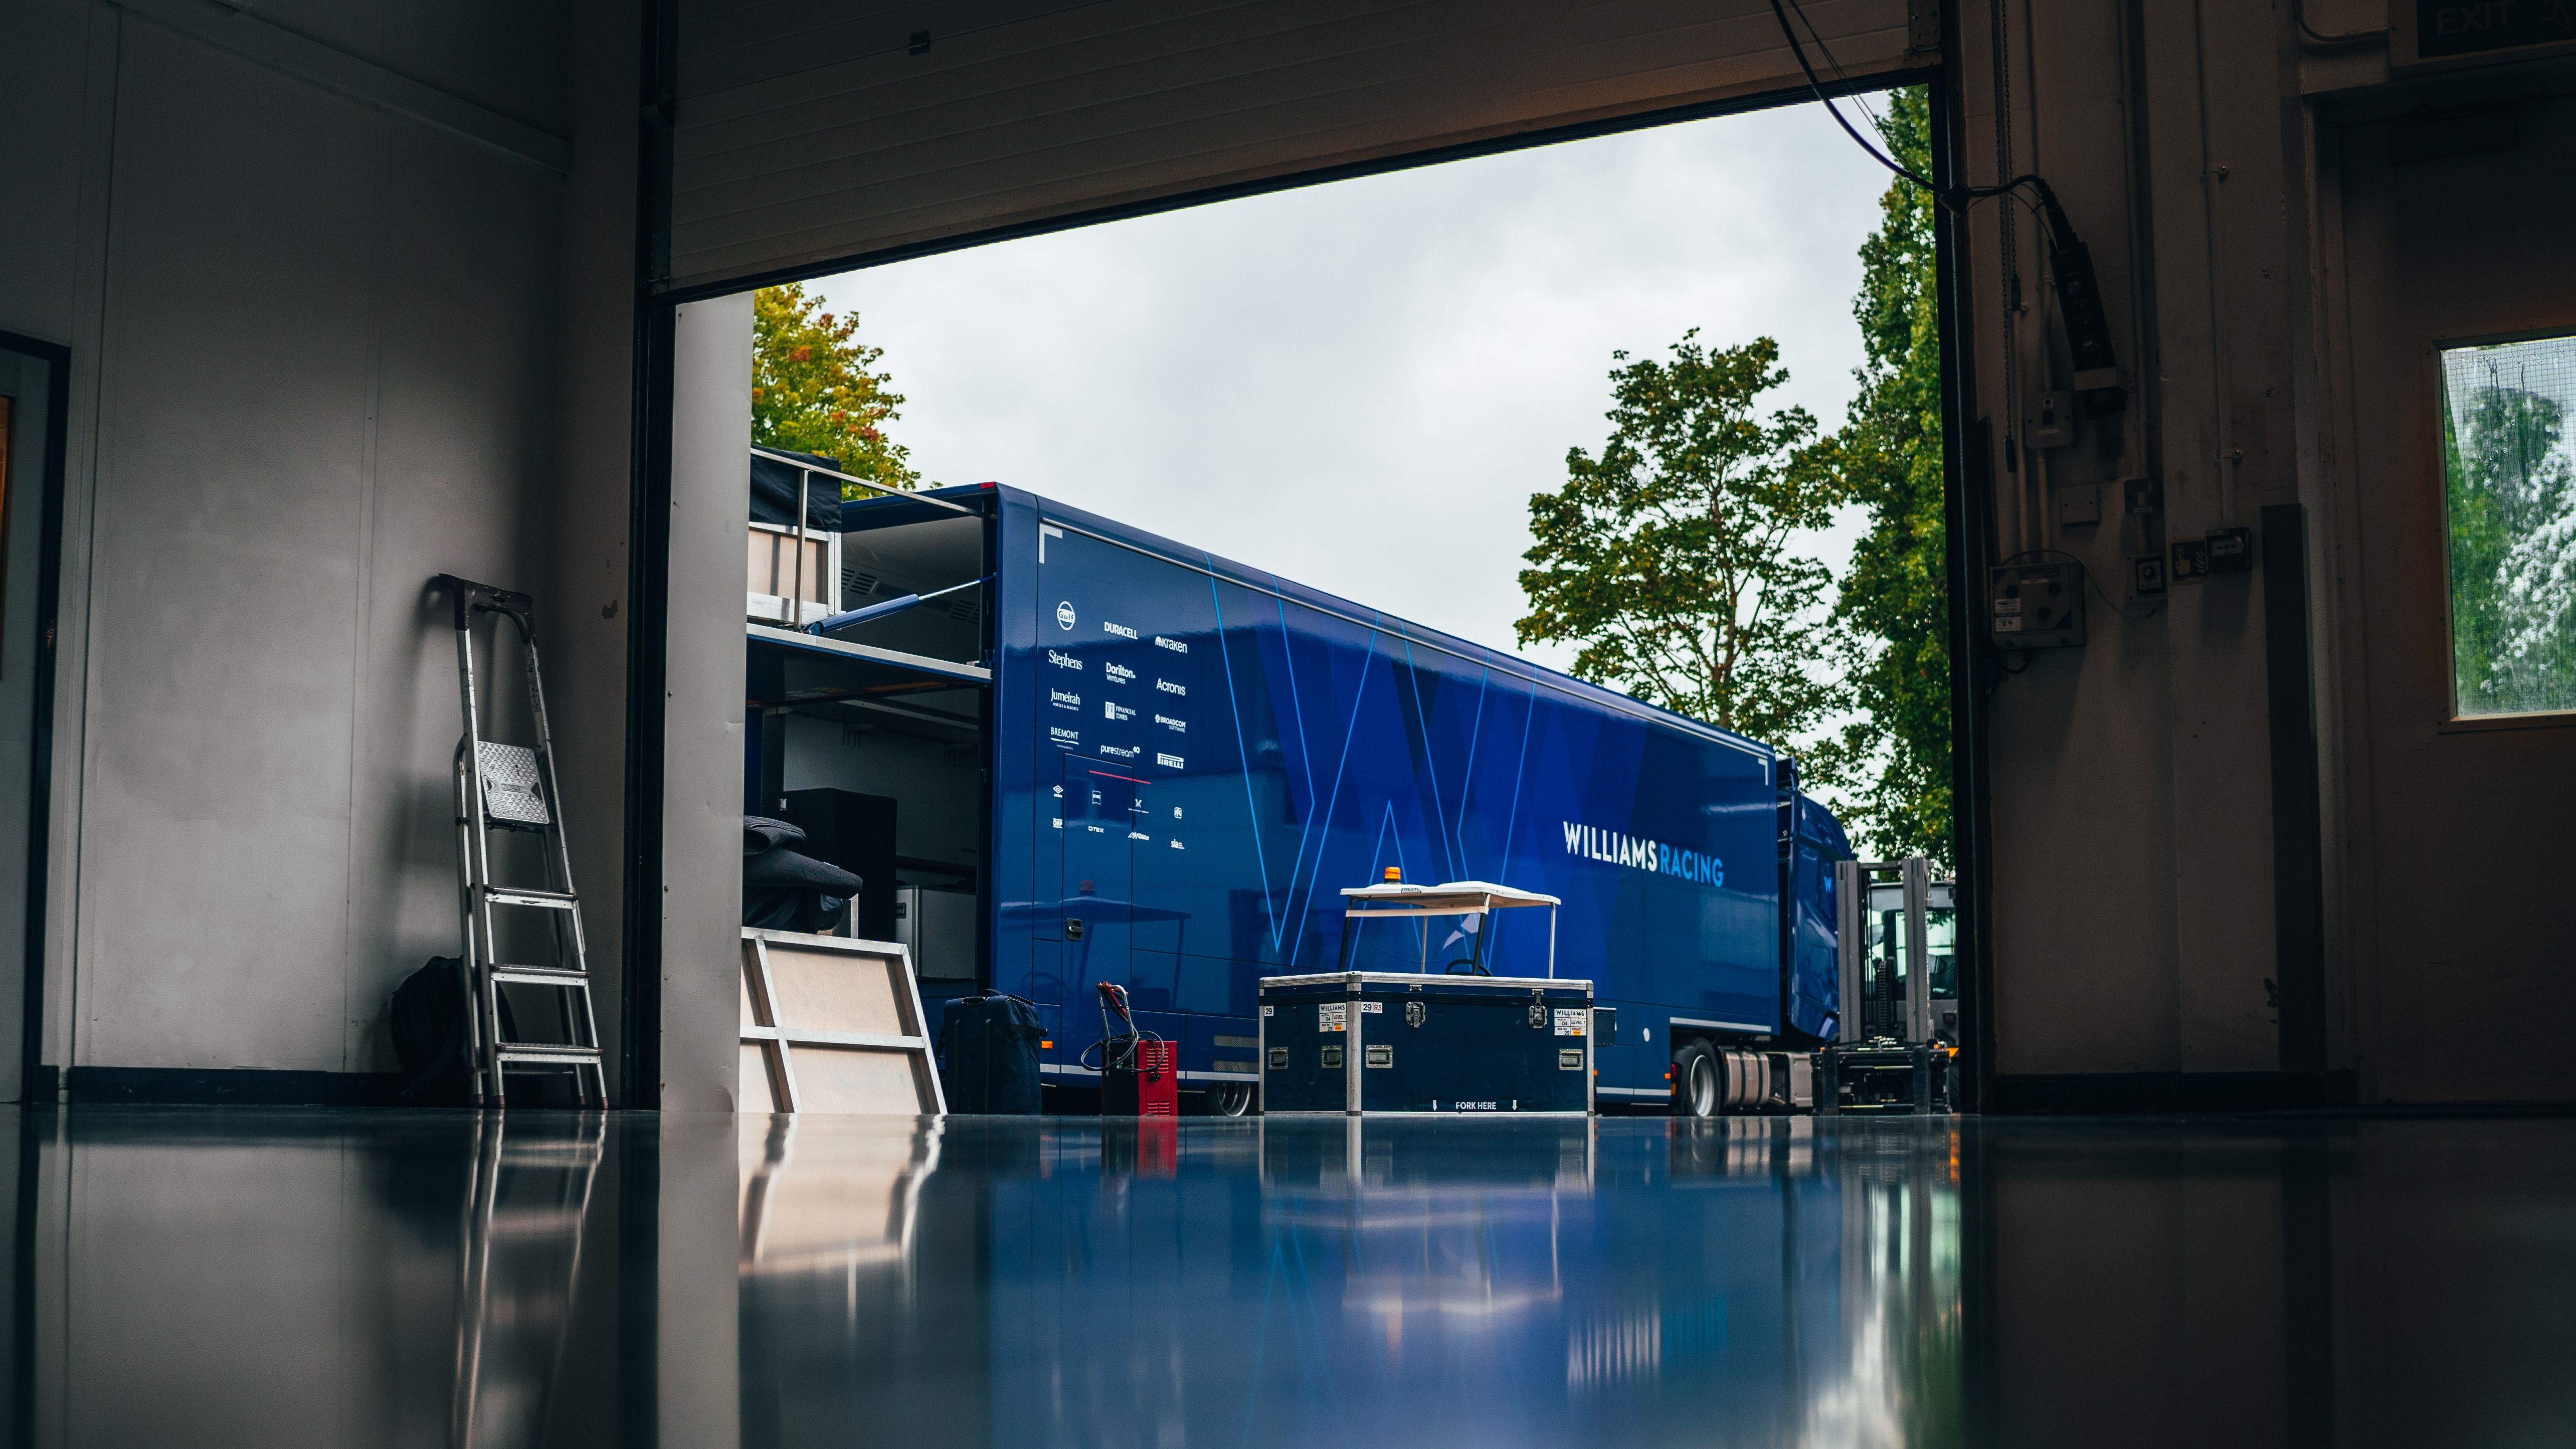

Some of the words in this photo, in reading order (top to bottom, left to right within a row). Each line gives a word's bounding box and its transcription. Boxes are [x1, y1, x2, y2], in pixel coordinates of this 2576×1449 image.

[2436, 2, 2515, 35] EXIT
[1058, 610, 1074, 621] Gulf
[1105, 622, 1138, 639] DURACELL
[1049, 650, 1082, 670] Stephens
[1106, 673, 1126, 684] Ventures
[1157, 678, 1185, 695] Acronis
[1051, 688, 1080, 705] Jumeirah
[1116, 706, 1136, 715] FINANCIAL
[1160, 716, 1186, 728] BROADCOM
[1051, 727, 1078, 740] BREMONT
[1100, 745, 1134, 758] purestream
[1158, 753, 1184, 769] PIRELLI
